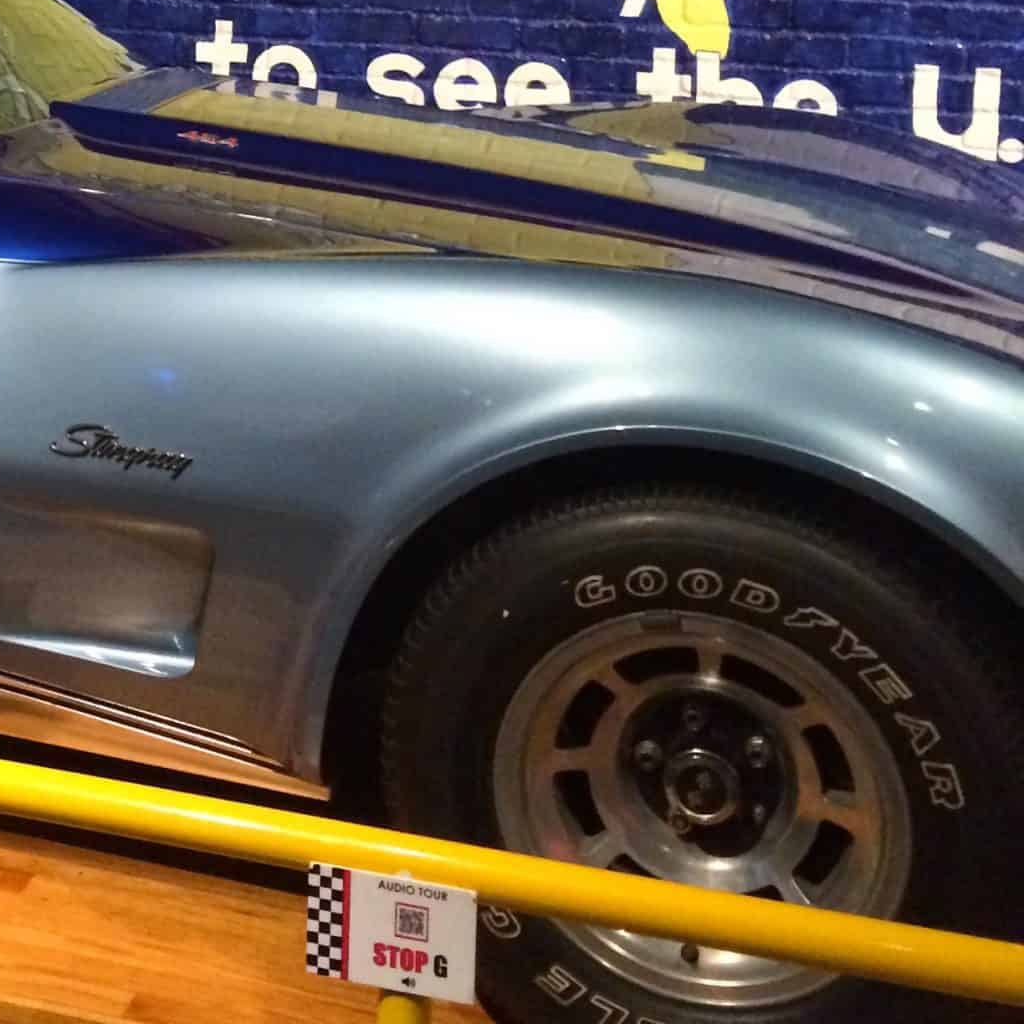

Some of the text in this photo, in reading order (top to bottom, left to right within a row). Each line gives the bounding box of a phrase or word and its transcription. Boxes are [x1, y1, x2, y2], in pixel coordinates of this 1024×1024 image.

[575, 564, 966, 812] GOODYEAR
[378, 880, 448, 901] AUDIO TOUR
[373, 942, 448, 979] STOP G
